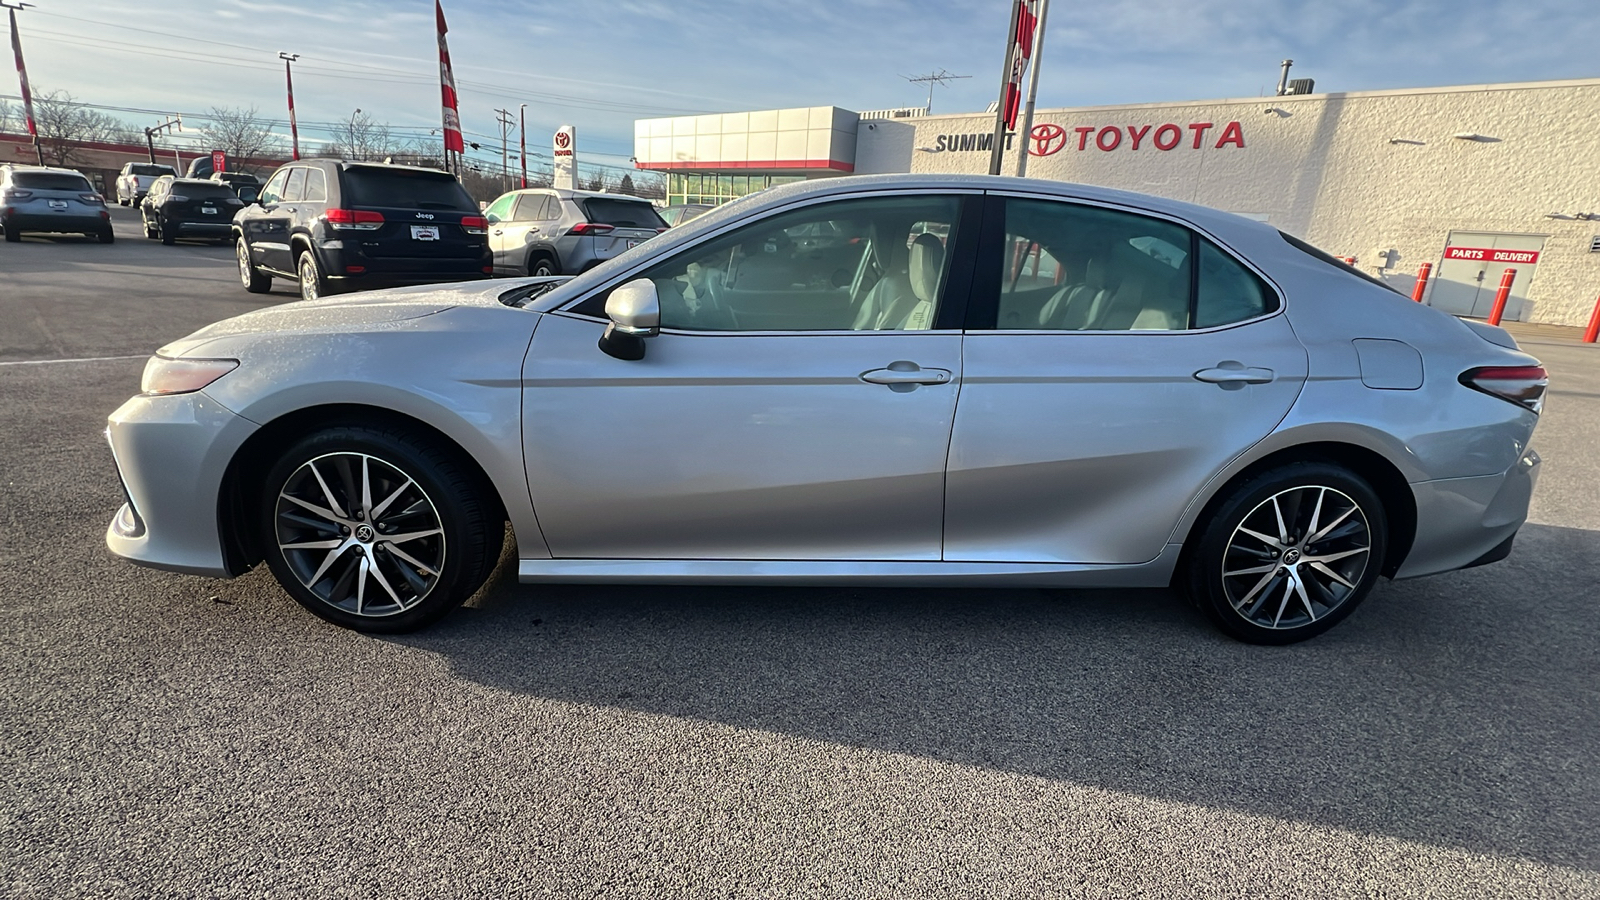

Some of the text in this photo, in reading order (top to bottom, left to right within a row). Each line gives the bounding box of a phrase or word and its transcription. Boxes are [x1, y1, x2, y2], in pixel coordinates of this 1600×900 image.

[936, 121, 1245, 152] SUMMT TOYOTA
[415, 212, 435, 220] Jeep
[1451, 249, 1535, 262] PARTS DELIVERY
